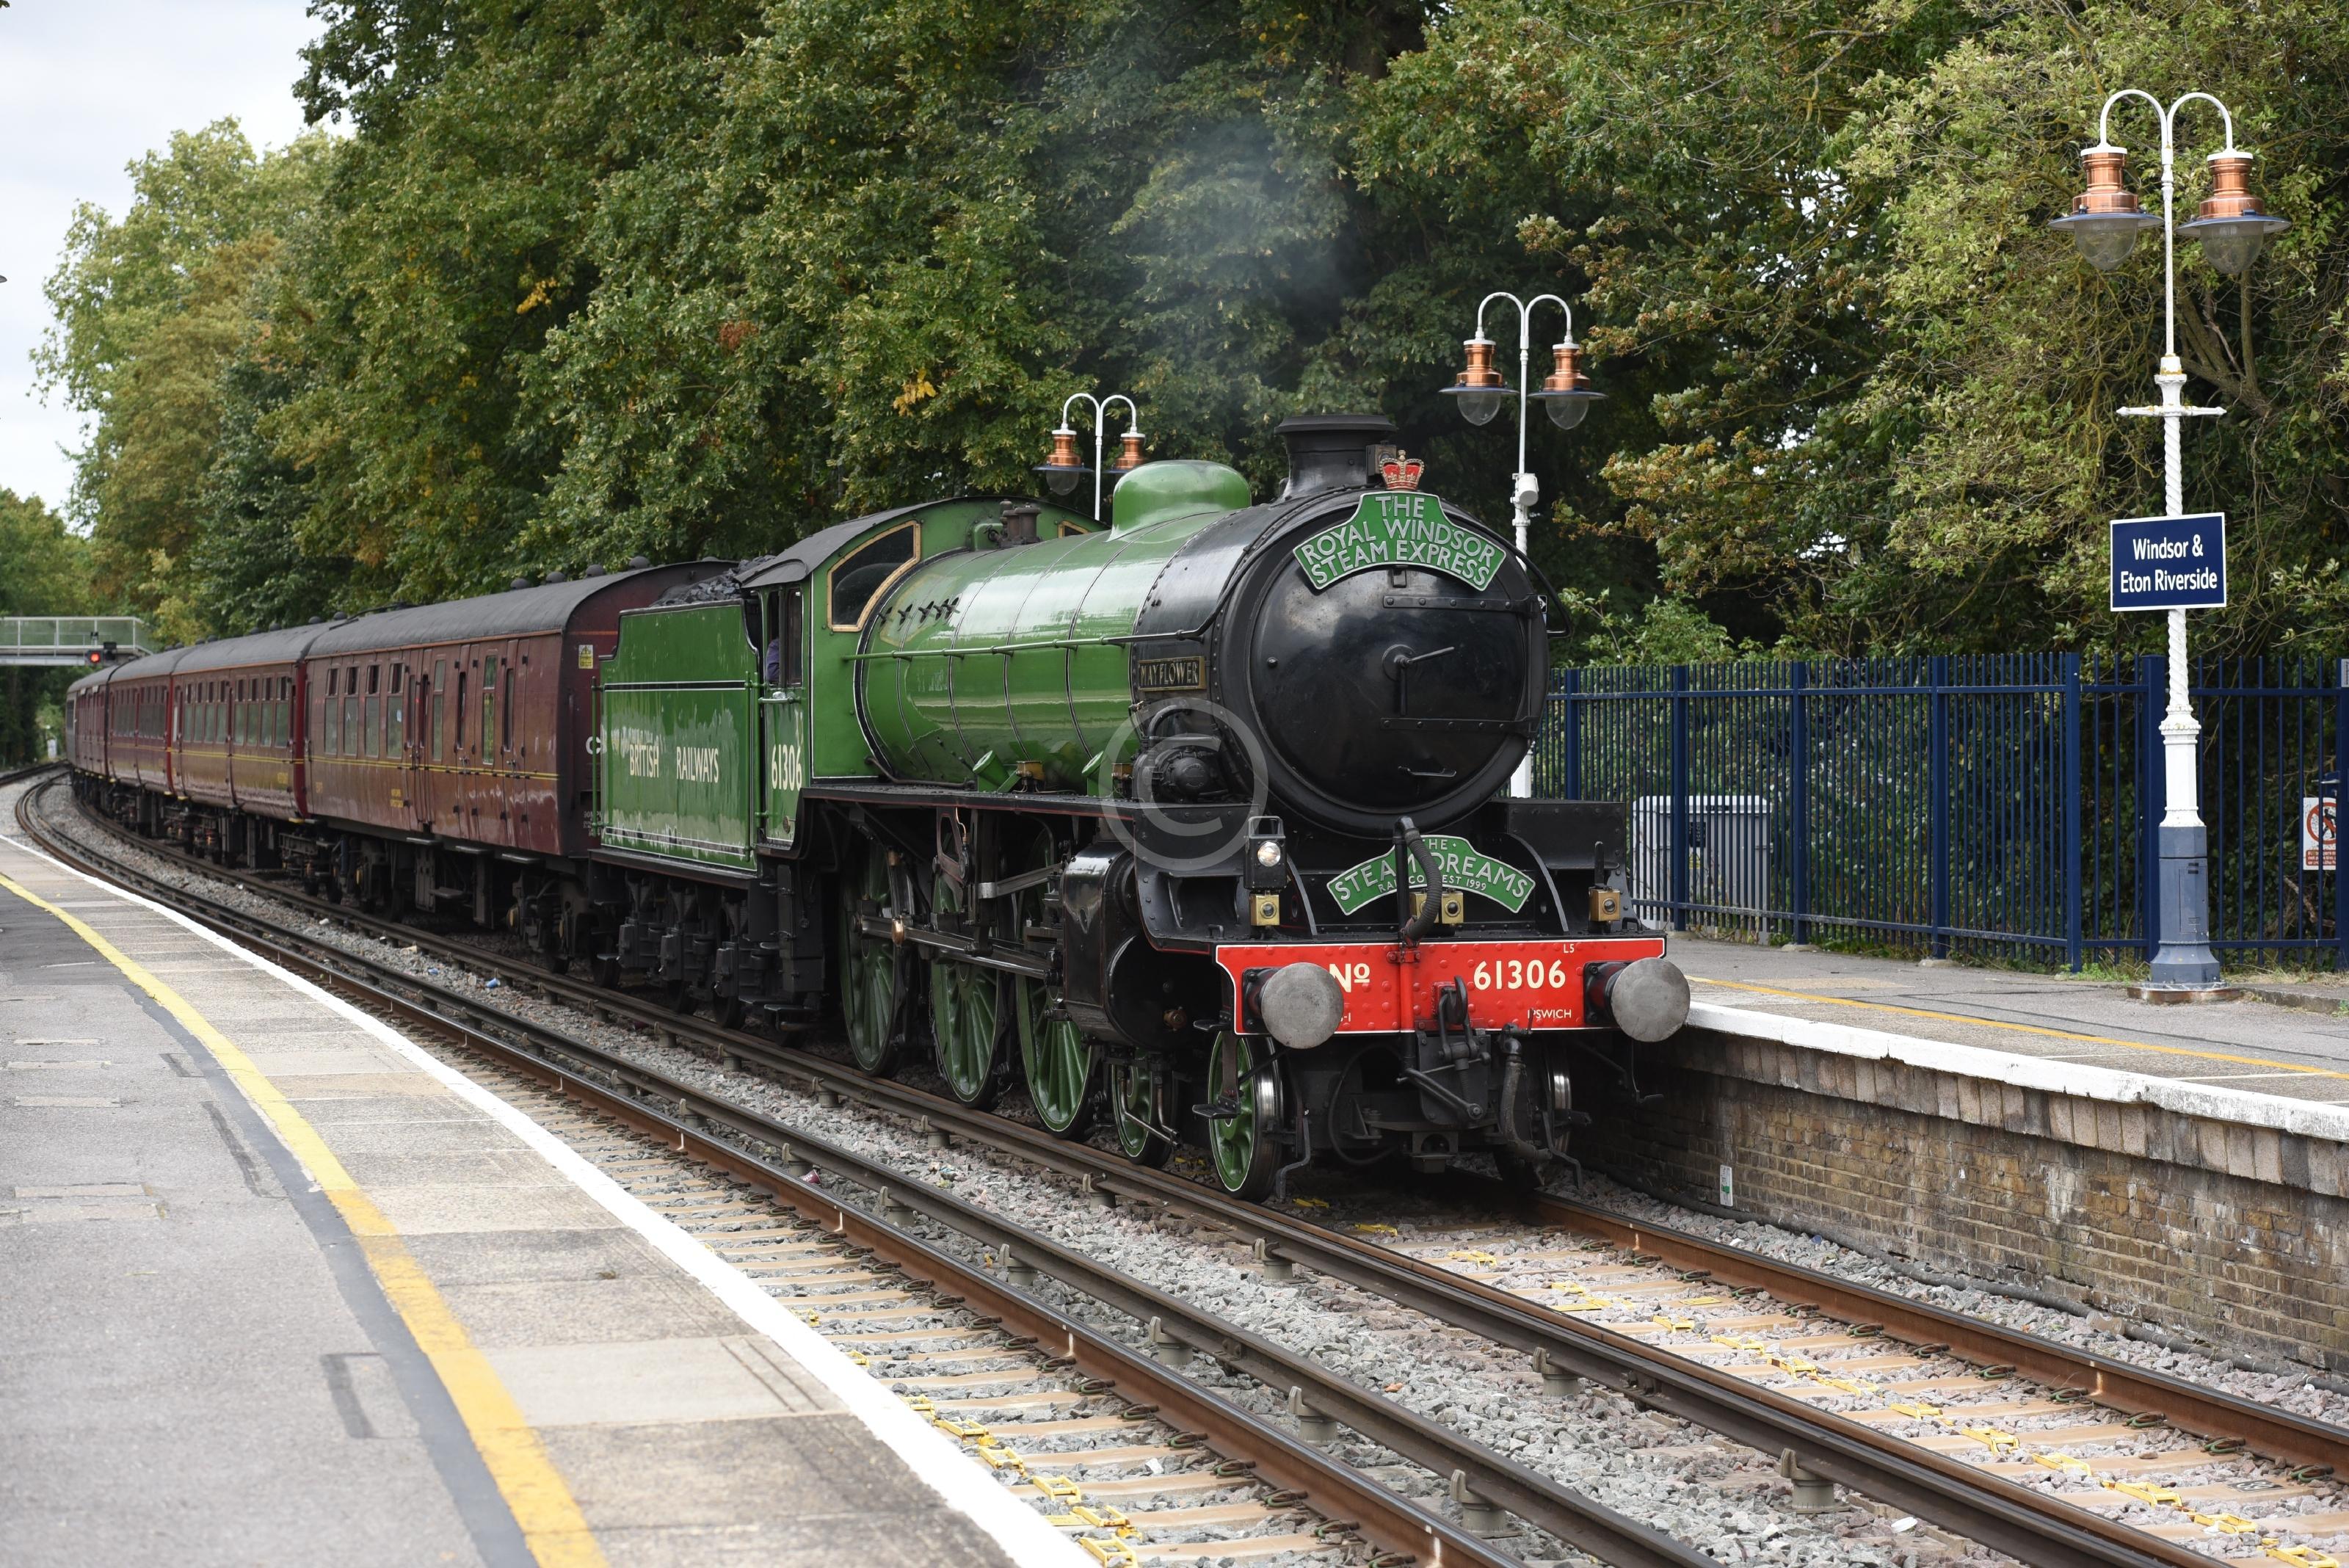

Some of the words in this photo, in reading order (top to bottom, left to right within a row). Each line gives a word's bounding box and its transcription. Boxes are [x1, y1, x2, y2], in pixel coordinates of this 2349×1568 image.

[1375, 496, 1426, 518] THE
[1303, 520, 1376, 565] ROYAL
[1383, 519, 1495, 567] WINDSOR
[2132, 537, 2188, 560] Windsor
[2192, 534, 2203, 556] &
[1311, 541, 1389, 585] STEAM
[1396, 540, 1490, 587] EXPRESS
[2120, 571, 2152, 592] Eton
[2154, 567, 2218, 591] Riverside
[1140, 661, 1198, 686] MAYFLOWER
[629, 742, 659, 778] BRITISH
[676, 746, 719, 783] RAILWAYS
[771, 744, 802, 791] 61306
[1422, 839, 1448, 851] HE
[1430, 852, 1528, 898] DREAMS
[1442, 874, 1462, 885] EST
[1466, 879, 1486, 891] 1999
[1474, 959, 1566, 990] 61306
